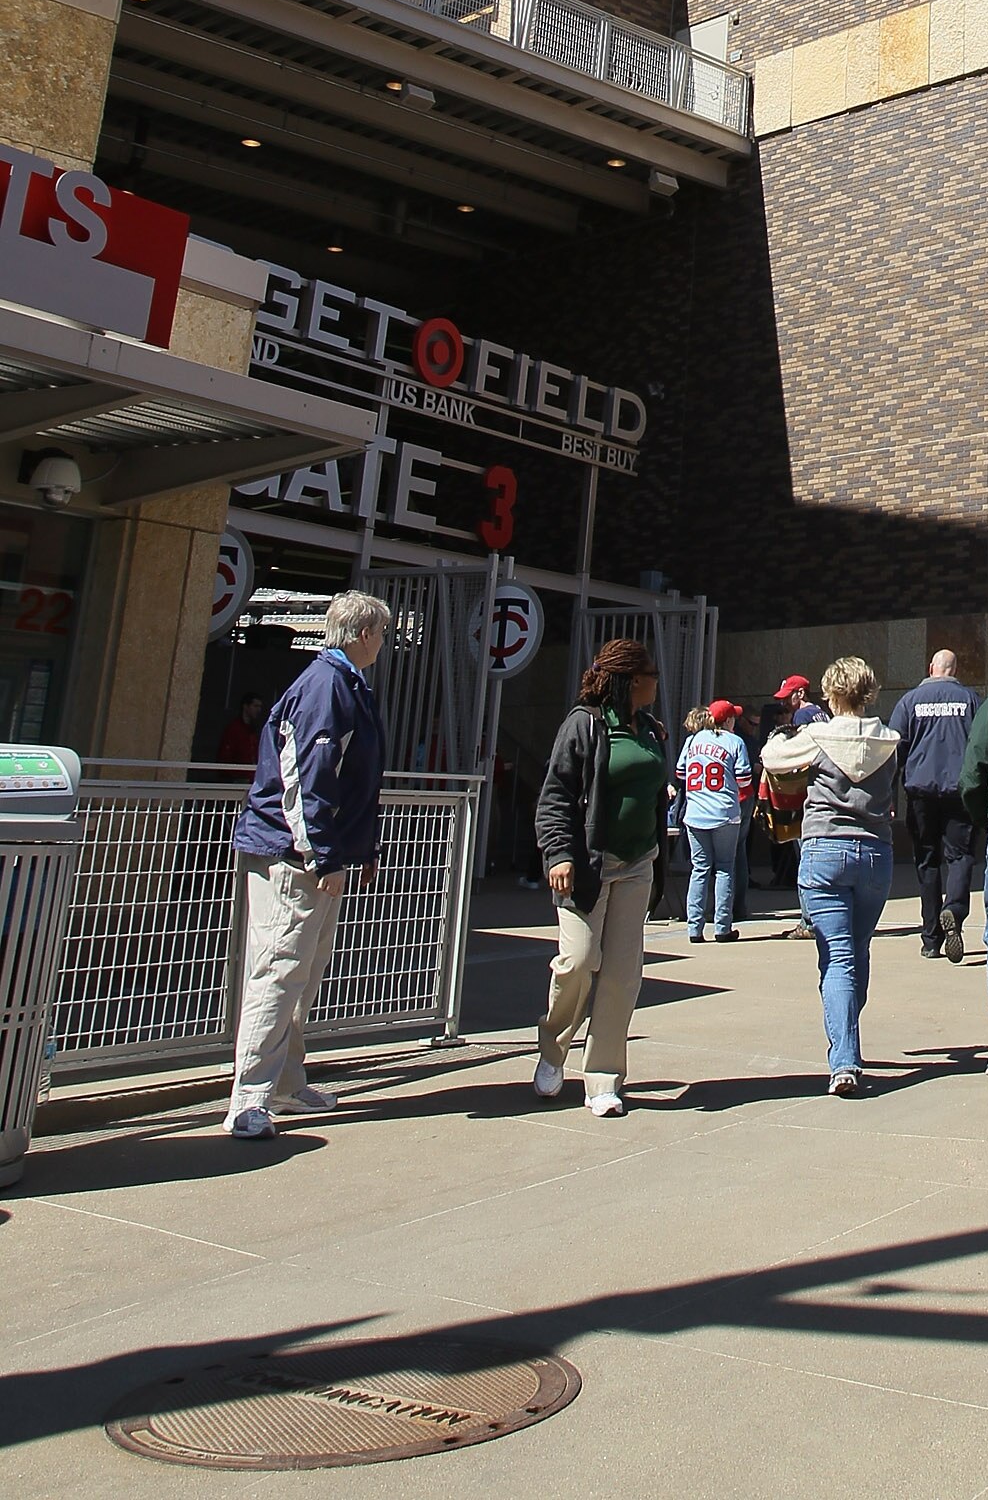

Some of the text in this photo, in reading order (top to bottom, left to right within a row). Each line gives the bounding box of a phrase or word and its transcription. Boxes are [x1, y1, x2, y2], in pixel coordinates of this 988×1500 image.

[0, 144, 112, 258] TS
[391, 380, 477, 426] US BANK
[475, 338, 647, 444] FIELD
[562, 433, 637, 472] BEST BUY
[481, 465, 518, 550] 3
[15, 588, 73, 636] 22
[915, 703, 967, 717] SECURITY
[688, 743, 728, 761] BLYLEVEN
[687, 762, 725, 792] 28
